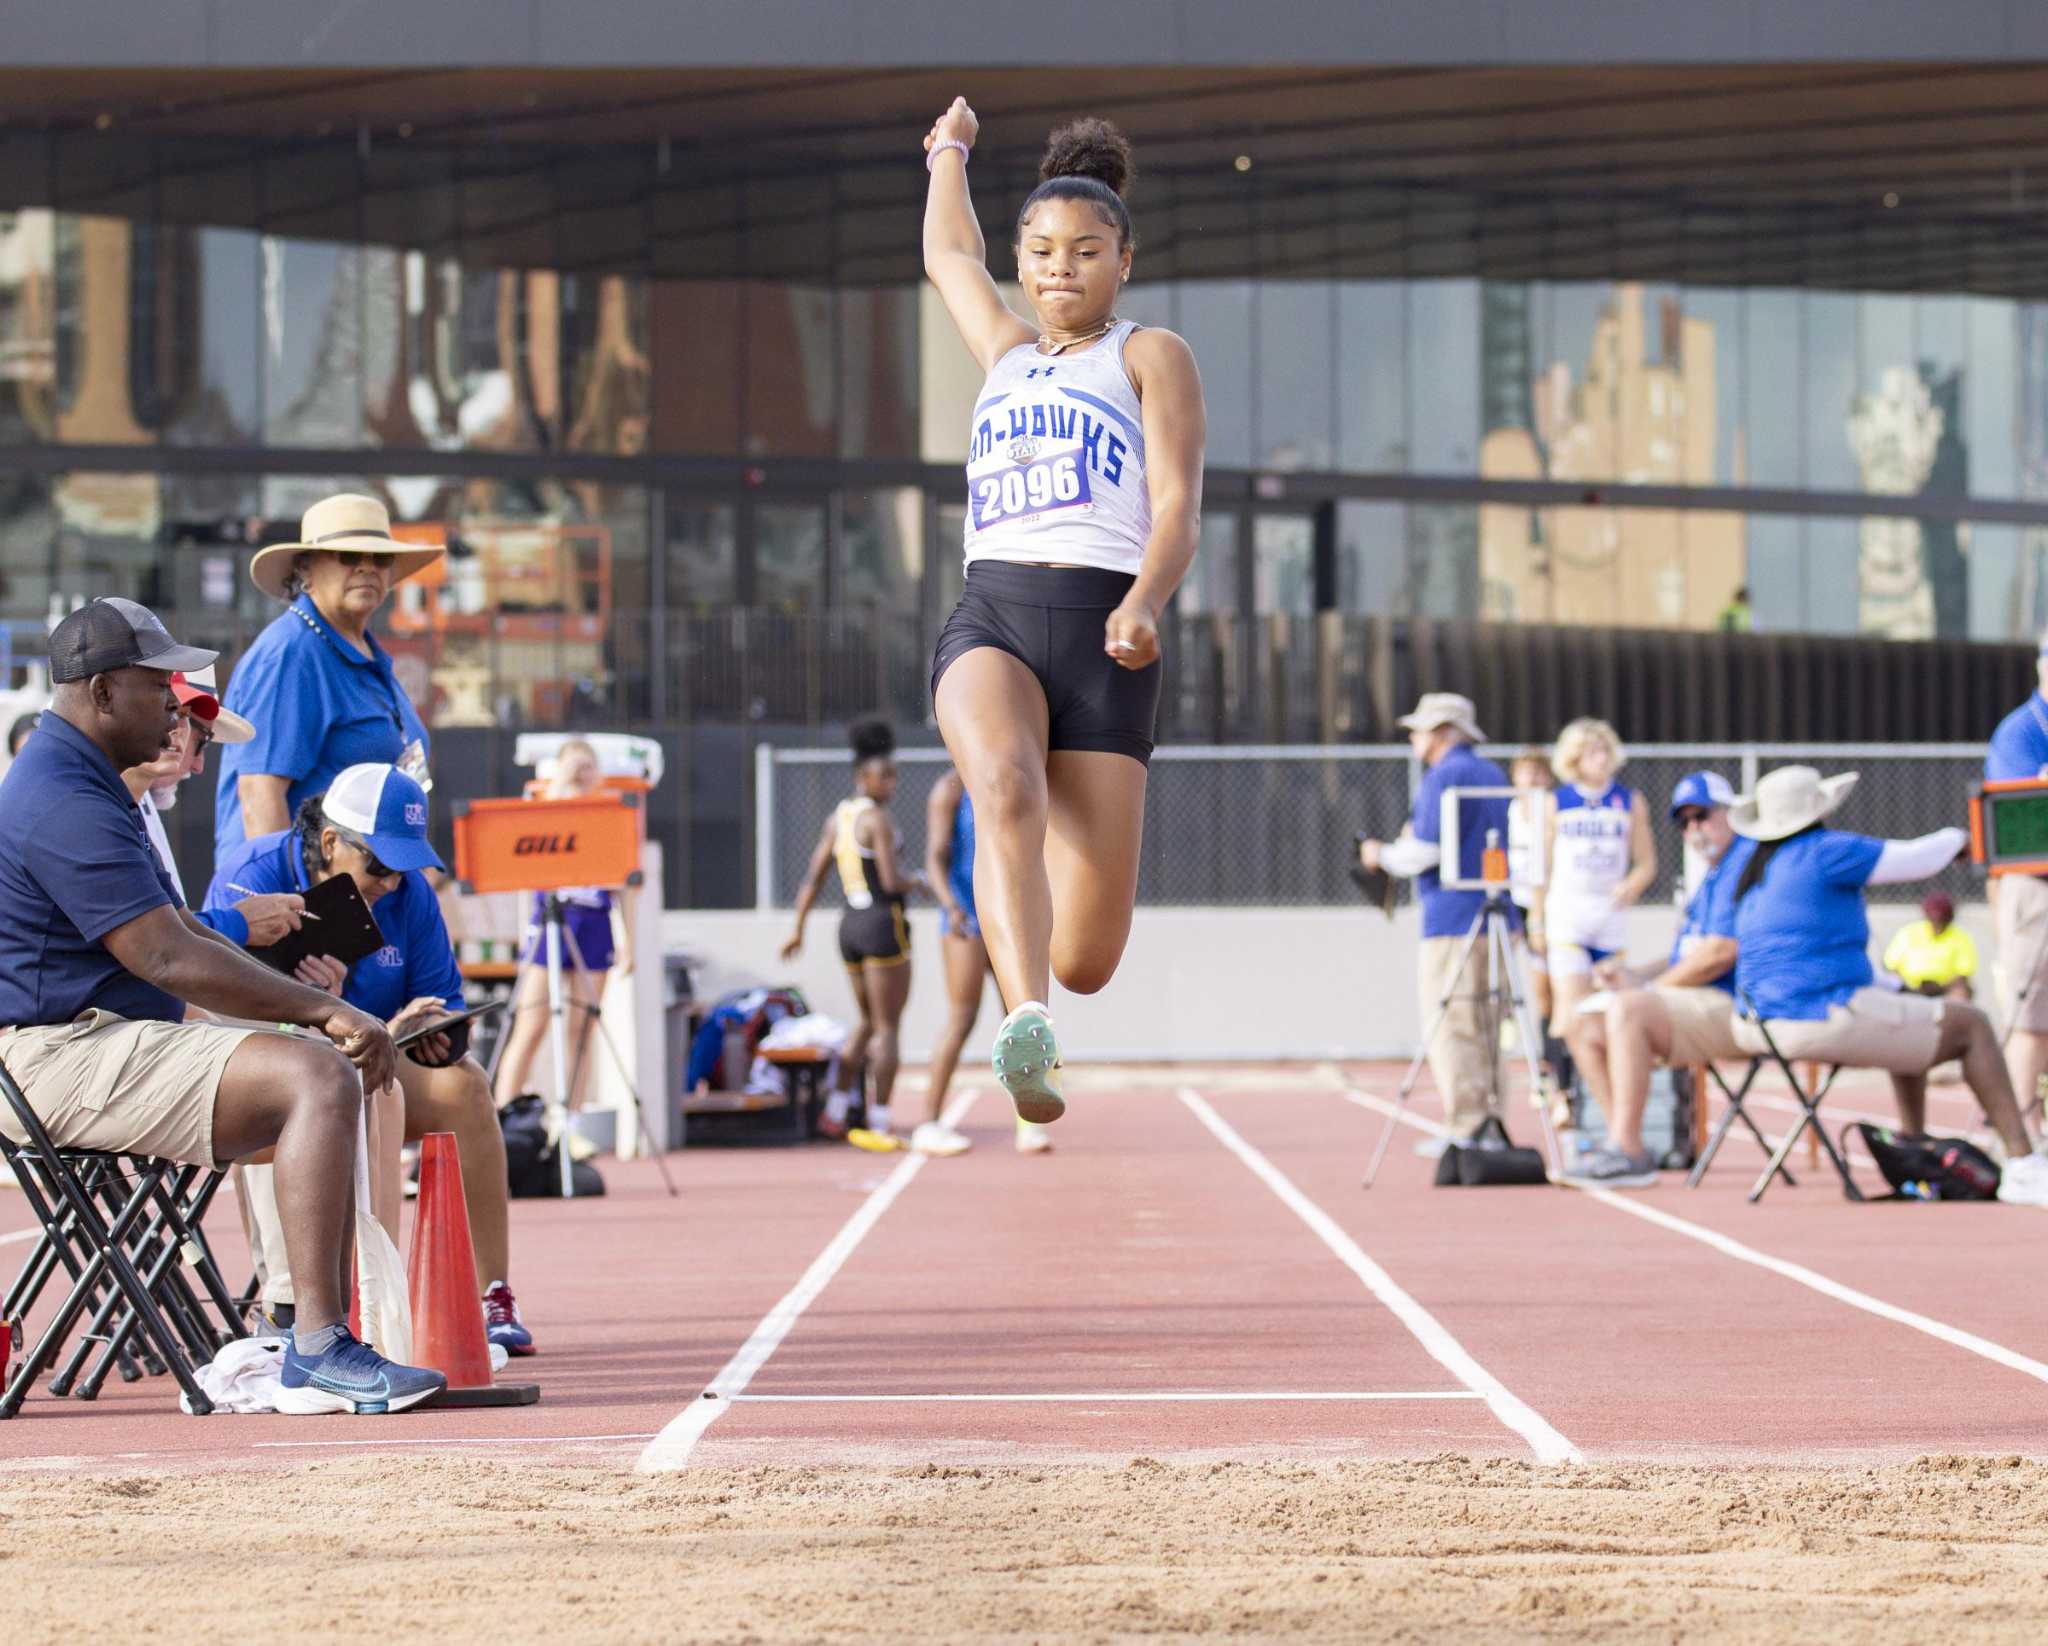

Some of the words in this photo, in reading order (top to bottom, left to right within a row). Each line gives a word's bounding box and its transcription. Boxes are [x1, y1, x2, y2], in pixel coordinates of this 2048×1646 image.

[979, 456, 1080, 521] 2096
[514, 833, 577, 856] GILL
[376, 944, 404, 967] UIL
